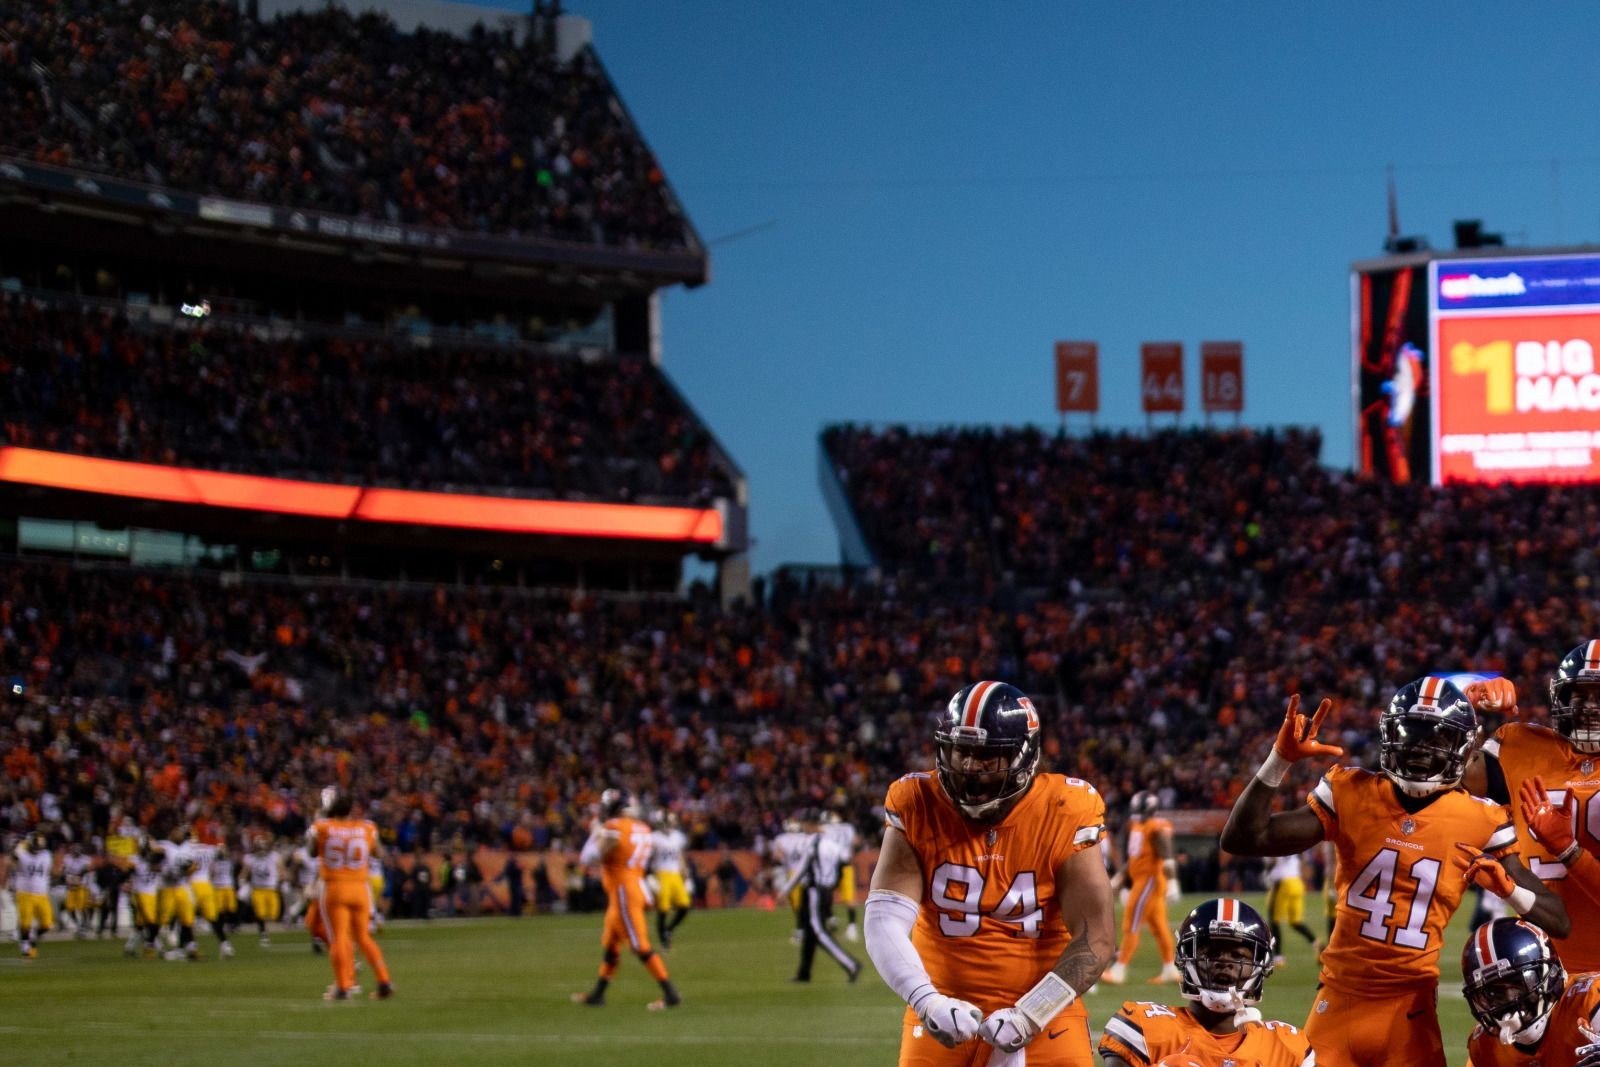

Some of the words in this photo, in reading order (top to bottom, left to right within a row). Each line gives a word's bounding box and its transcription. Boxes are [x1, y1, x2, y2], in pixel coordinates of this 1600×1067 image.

[1515, 339, 1594, 376] BIG
[1066, 371, 1089, 402] 7
[1206, 372, 1238, 401] 18
[1385, 837, 1424, 851] BRONCOS
[931, 862, 1045, 939] 94
[1347, 847, 1442, 950] 41
